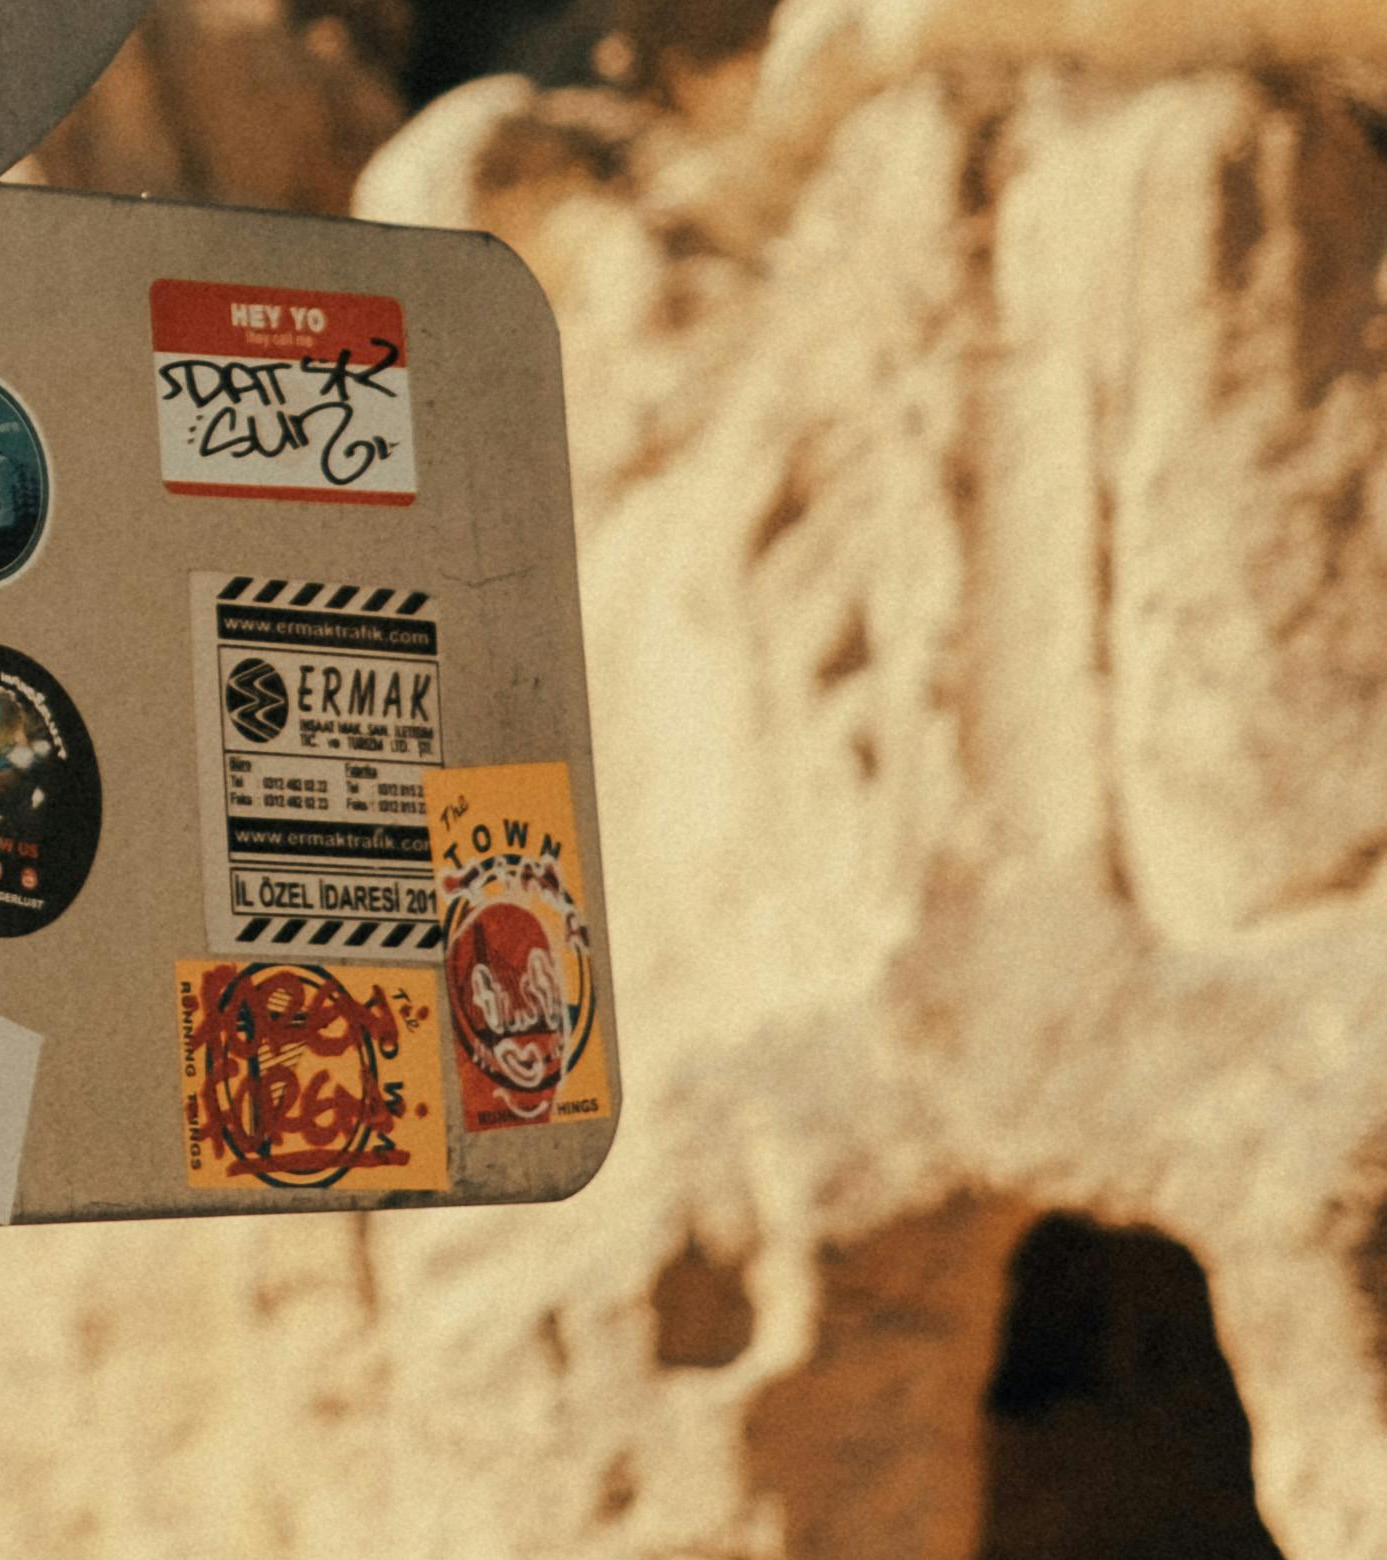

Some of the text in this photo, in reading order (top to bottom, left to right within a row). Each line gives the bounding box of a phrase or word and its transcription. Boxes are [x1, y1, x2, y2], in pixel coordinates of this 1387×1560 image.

[230, 302, 326, 332] HEY YO
[224, 615, 430, 645] www.ermaktrafik.com
[297, 665, 432, 722] ERMAK
[439, 796, 470, 833] The
[443, 818, 562, 870] TOWN
[259, 876, 314, 910] ÖZEL
[319, 878, 400, 912] İDARESİ
[406, 887, 437, 914] 201
[556, 1098, 599, 1115] HINGS
